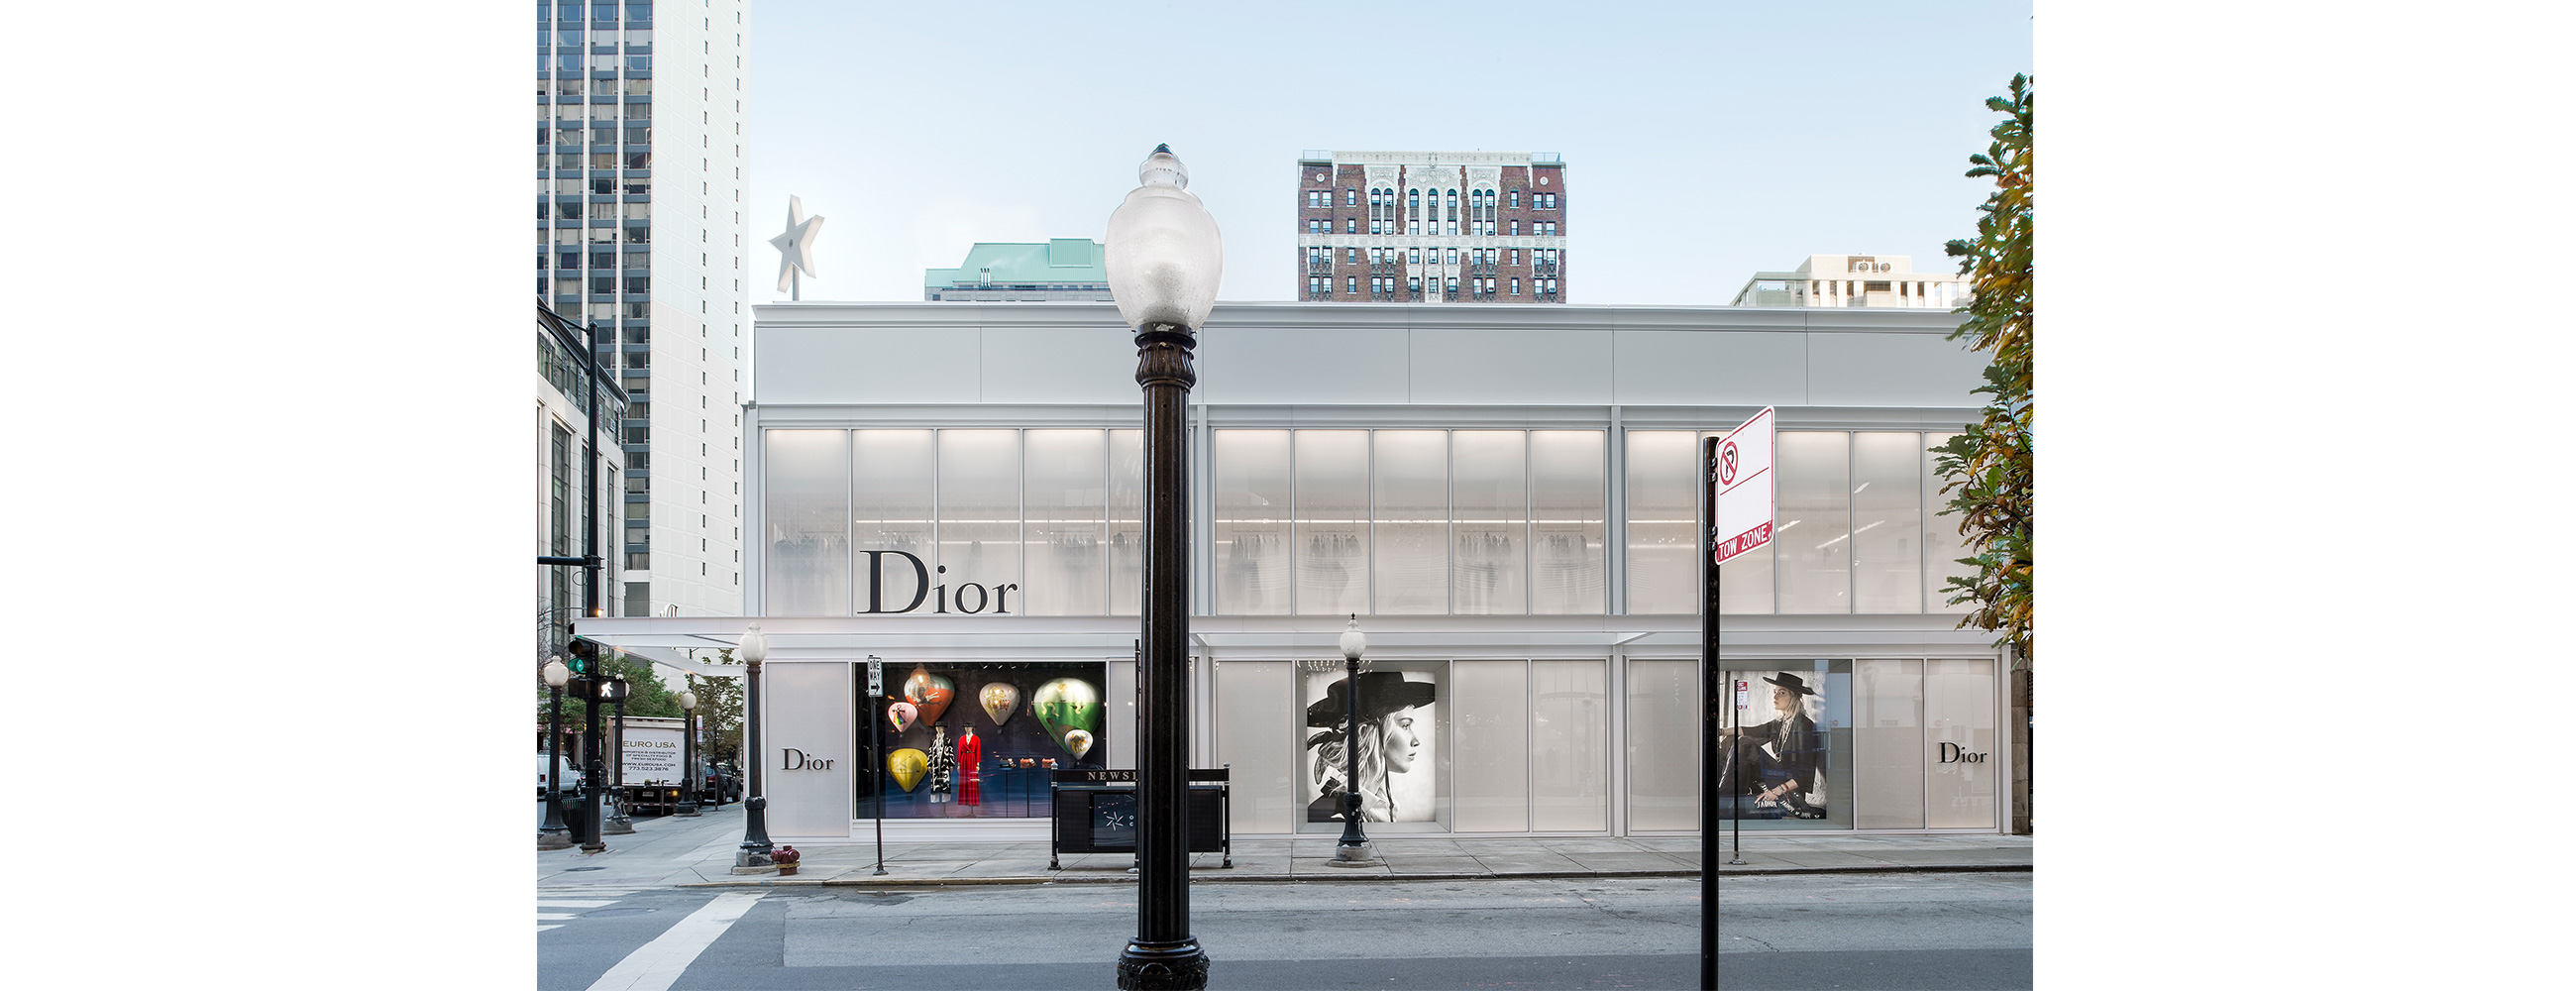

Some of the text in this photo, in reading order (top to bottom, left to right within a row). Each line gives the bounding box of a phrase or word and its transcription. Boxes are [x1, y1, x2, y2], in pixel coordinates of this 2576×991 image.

[1719, 524, 1768, 560] TOW ZONE
[857, 550, 1019, 614] Dior
[869, 659, 880, 670] ONE
[869, 671, 880, 681] WAY
[781, 747, 834, 771] Dior
[1937, 742, 1987, 764] Dior
